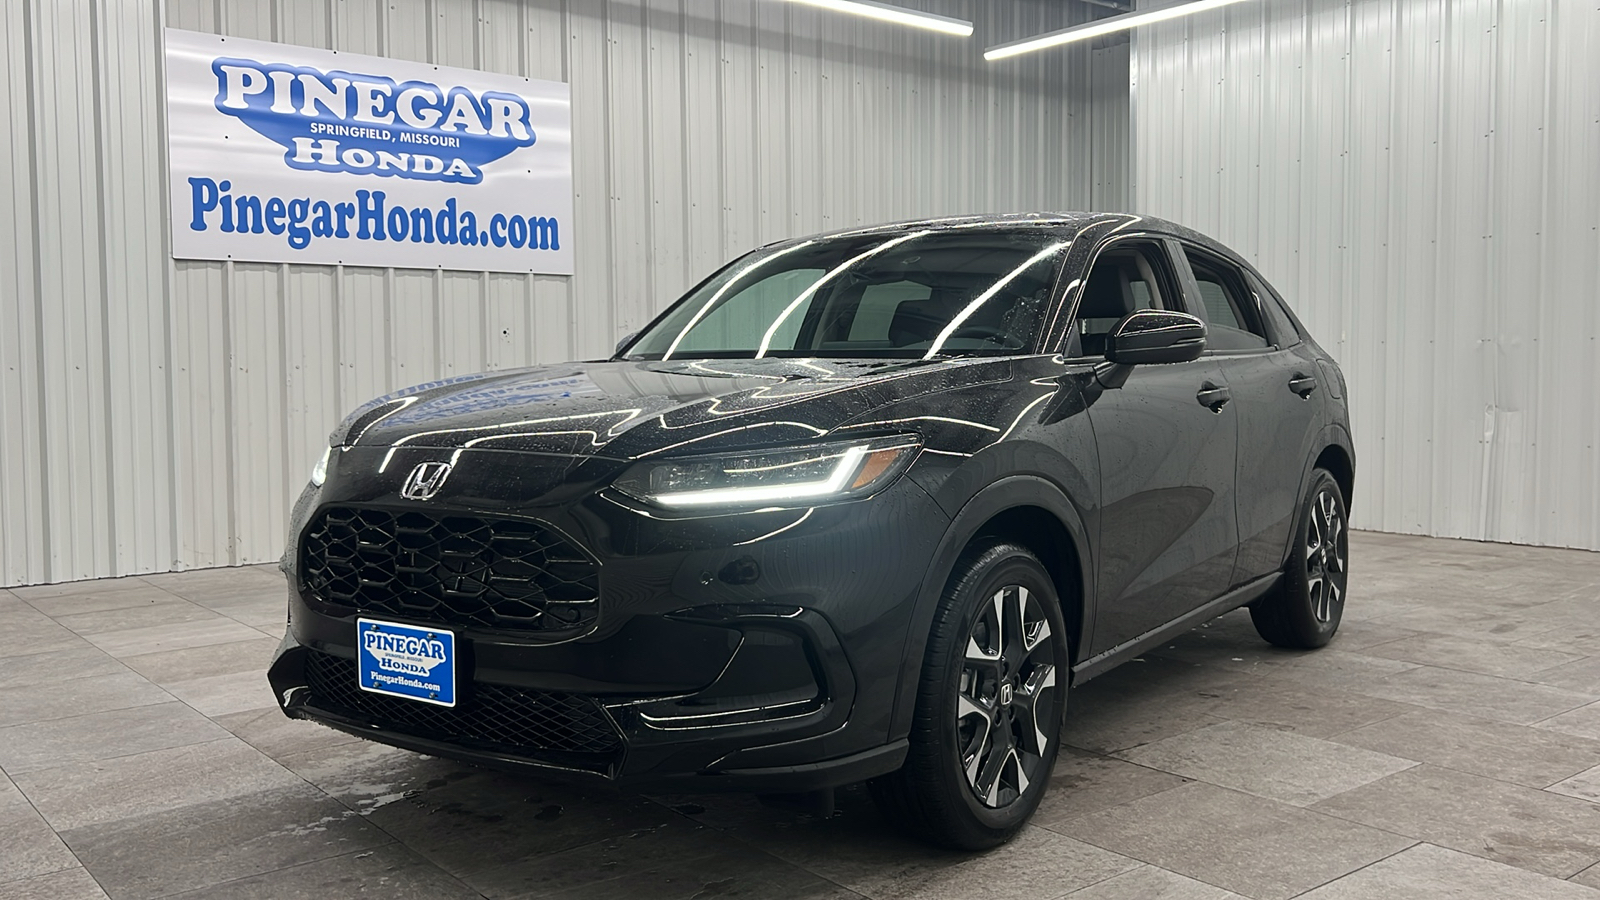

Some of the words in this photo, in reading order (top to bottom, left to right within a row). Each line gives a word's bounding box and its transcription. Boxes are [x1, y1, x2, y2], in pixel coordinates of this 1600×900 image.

[219, 65, 532, 140] PINEGAR
[310, 122, 397, 143] SPRINGFIELD,
[400, 131, 461, 148] MISSOURI
[291, 137, 477, 177] HONDA
[187, 177, 560, 250] PinegarHonda.com
[366, 633, 444, 660] PINEGAR
[381, 657, 428, 674] HONDA
[370, 671, 441, 691] PinegarHonda.com
